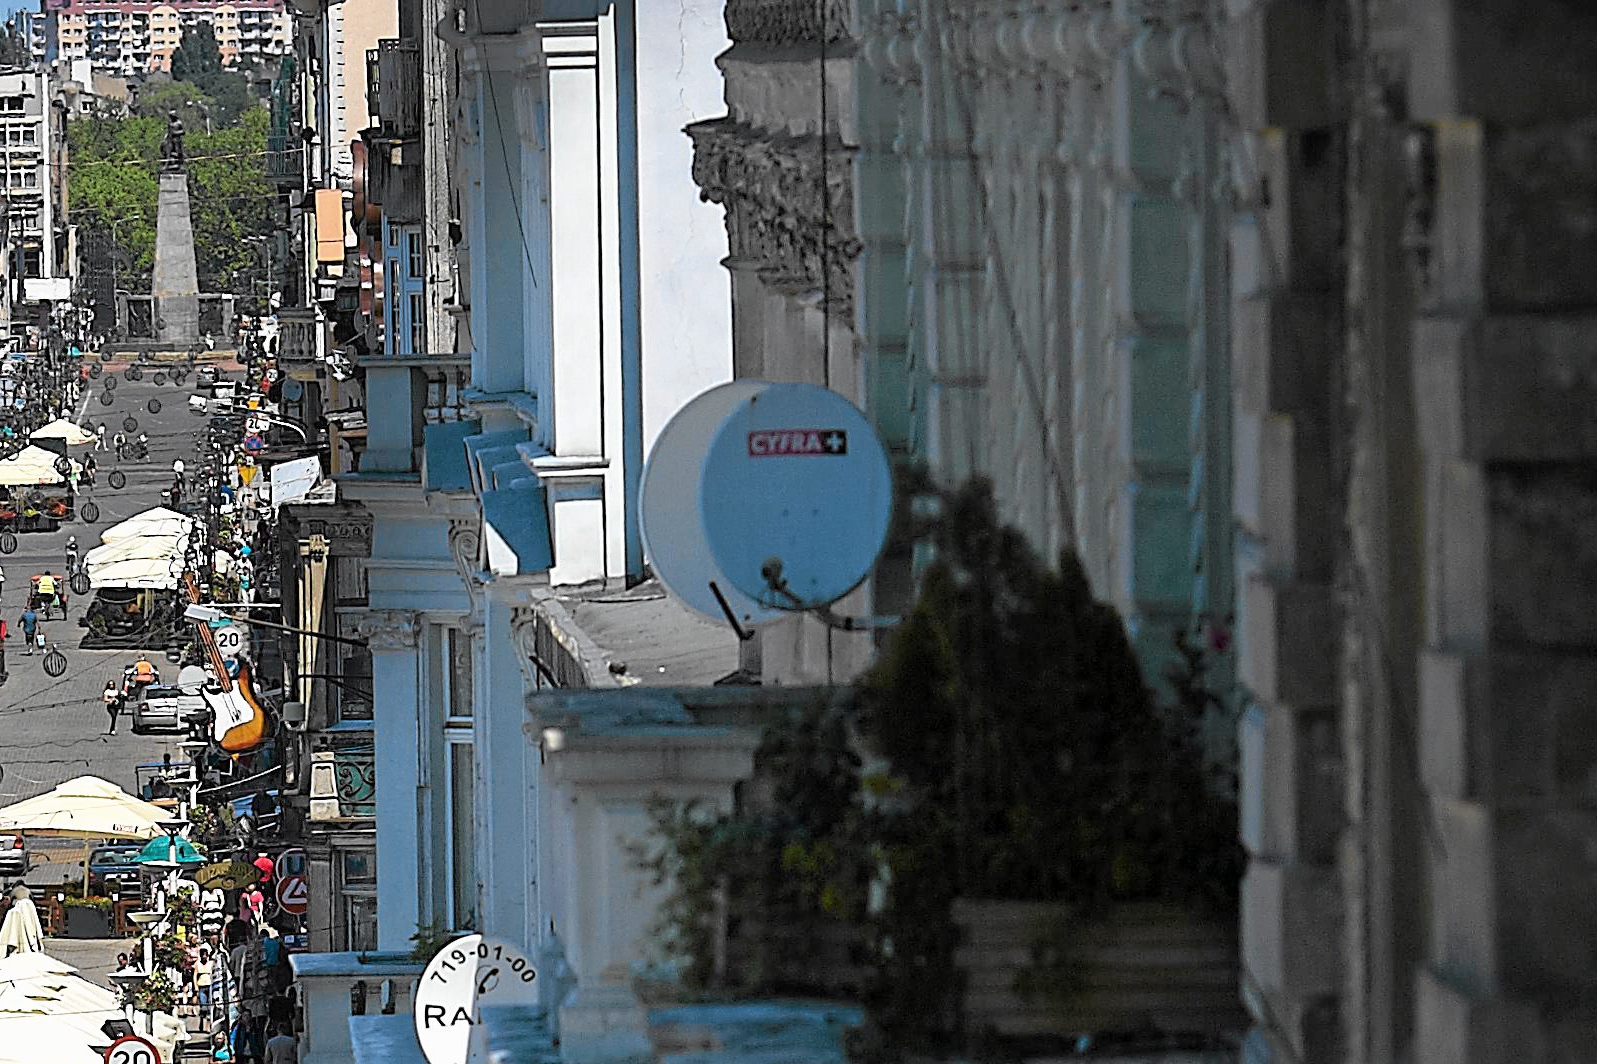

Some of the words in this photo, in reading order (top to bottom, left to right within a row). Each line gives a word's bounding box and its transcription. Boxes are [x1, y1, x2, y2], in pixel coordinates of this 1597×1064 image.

[218, 632, 239, 647] 20
[430, 943, 536, 984] 719-01-00
[424, 1004, 482, 1029] RA
